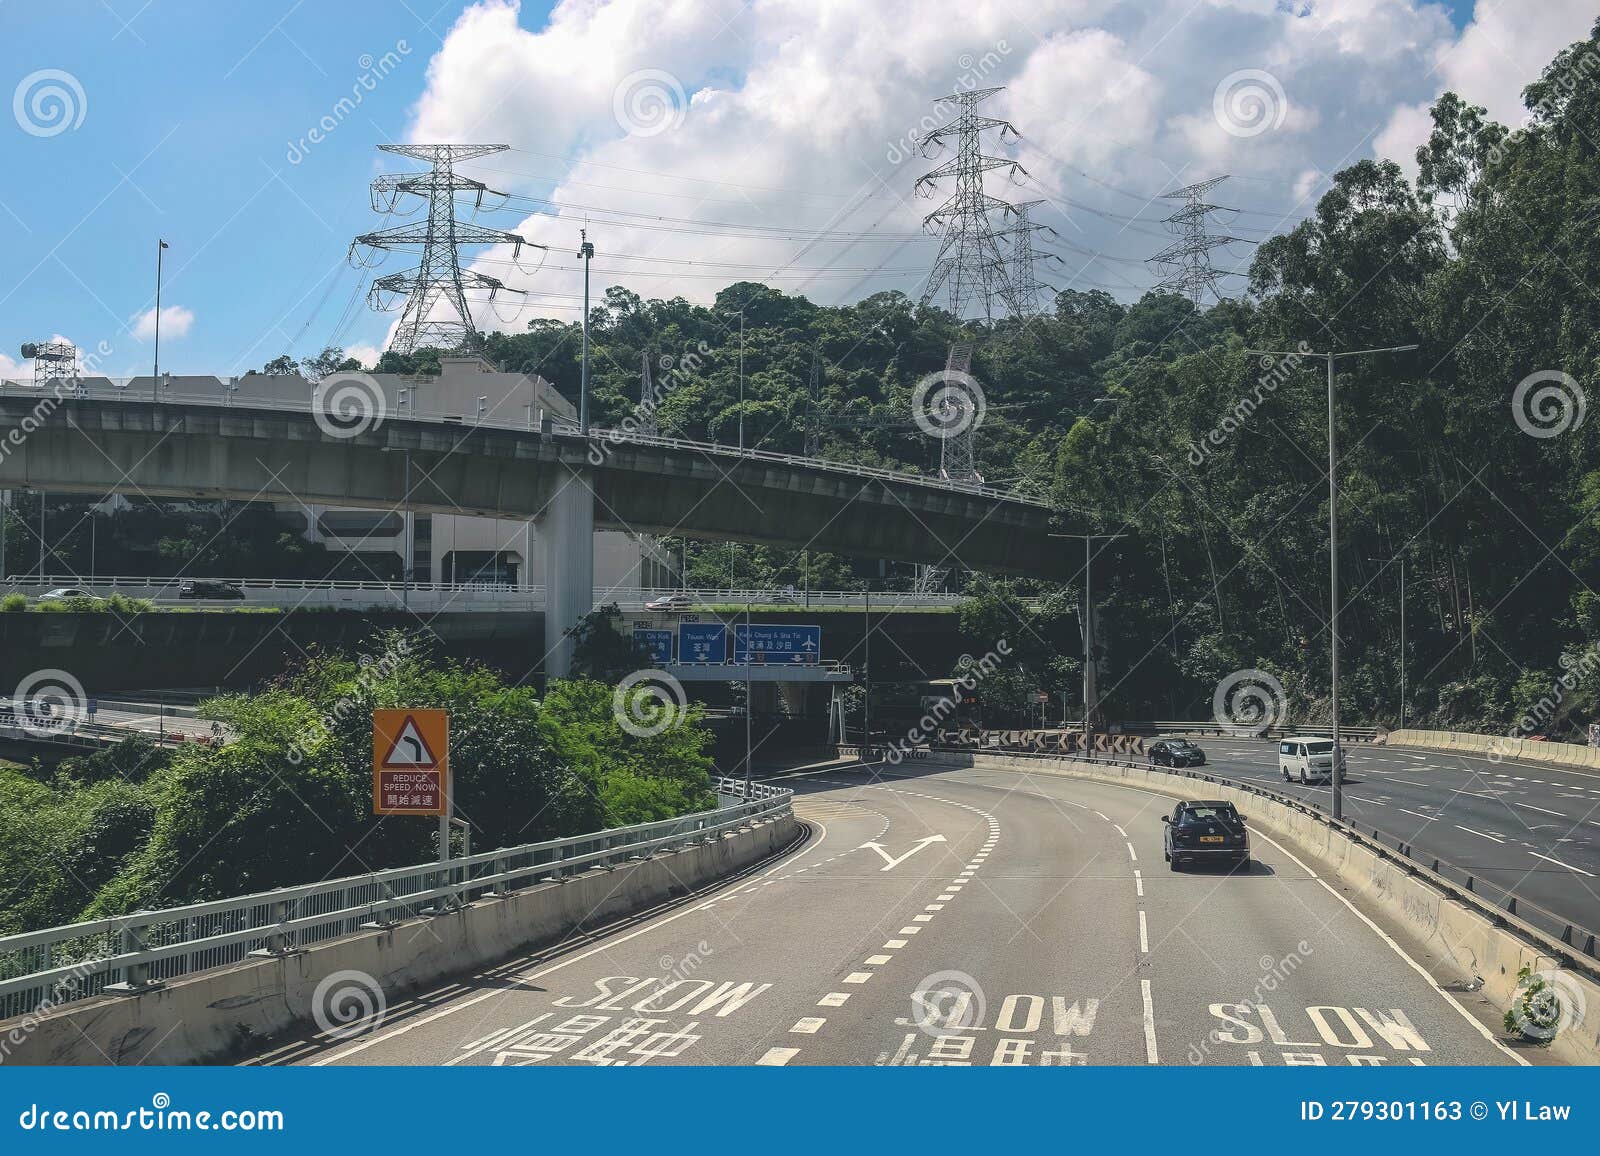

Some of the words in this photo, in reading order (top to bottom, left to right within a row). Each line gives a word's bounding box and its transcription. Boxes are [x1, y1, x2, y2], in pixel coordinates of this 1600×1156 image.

[383, 783, 411, 792] SPEED
[415, 783, 436, 792] NOW
[392, 774, 428, 783] REDUCE
[387, 794, 433, 806] 開始減速
[551, 975, 774, 1018] SLOW
[894, 990, 1100, 1037] SLOW
[1207, 1002, 1432, 1051] SLOW
